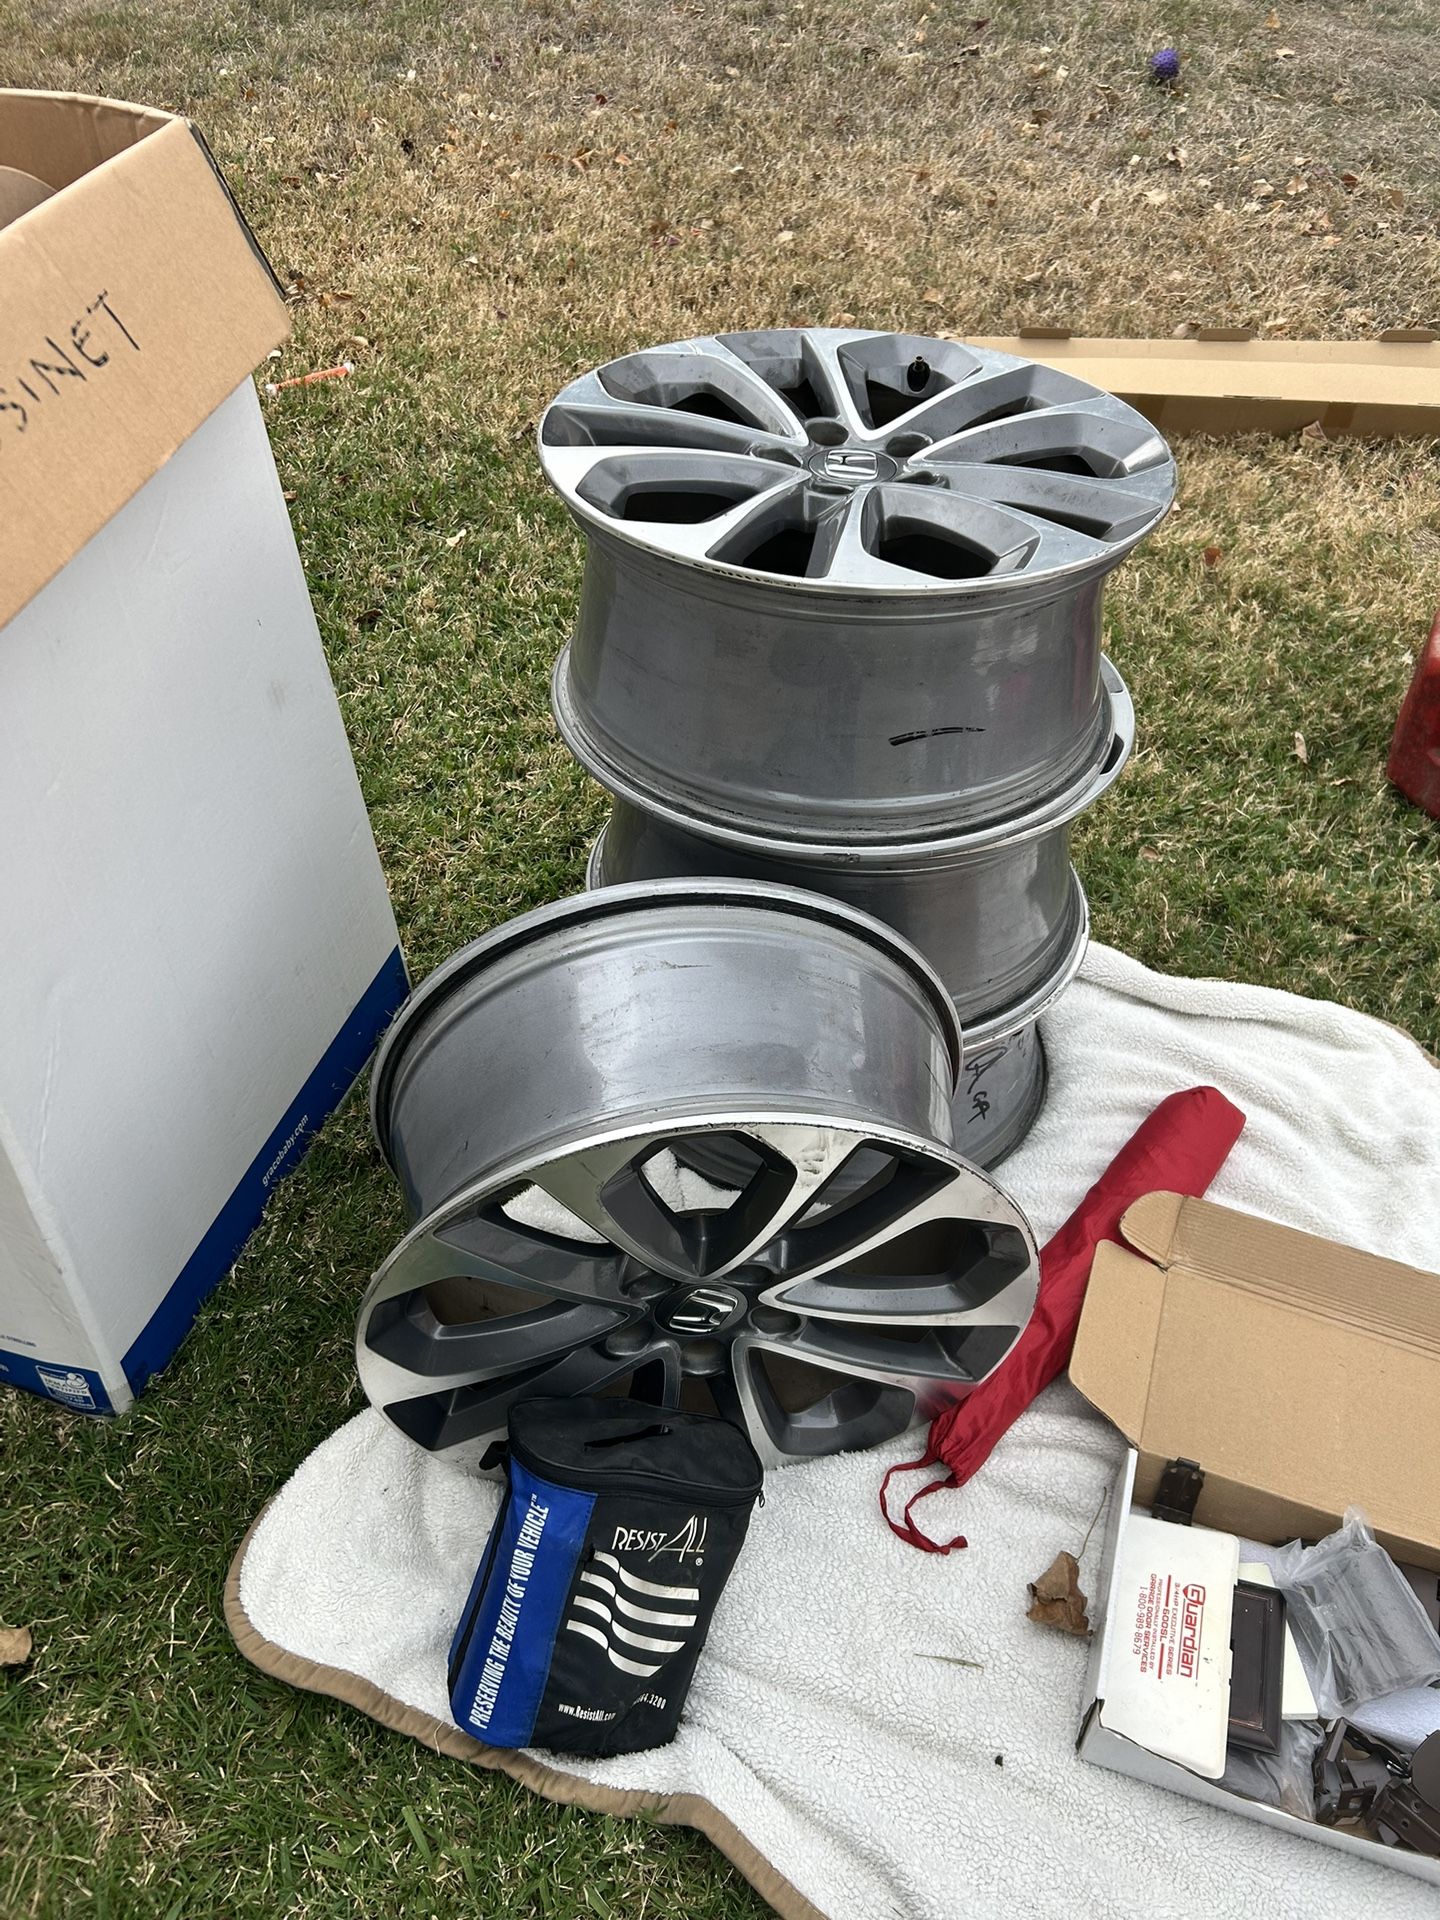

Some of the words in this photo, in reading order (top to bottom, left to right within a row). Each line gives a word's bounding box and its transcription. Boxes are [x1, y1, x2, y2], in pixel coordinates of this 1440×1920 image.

[0, 289, 141, 450] SINET
[261, 1114, 309, 1188] gracobaby.com
[509, 1548, 536, 1582] YOUR
[506, 1578, 526, 1599] OF
[1147, 1573, 1157, 1606] GARAGE
[1153, 1578, 1163, 1628] PROFESSIONALLY
[1173, 1582, 1181, 1607] 3/4HP
[495, 1594, 522, 1642] BEAUTY
[1144, 1605, 1154, 1629] DOOR
[1159, 1608, 1170, 1642] 600SL
[1169, 1607, 1179, 1646] EXECUTIVE
[1180, 1583, 1207, 1678] Guardian
[488, 1635, 511, 1662] THE
[1140, 1629, 1151, 1673] SERVICES
[1149, 1627, 1158, 1660] INSTALLED
[1148, 1661, 1154, 1671] BY
[1165, 1646, 1175, 1676] SERIES
[468, 1658, 506, 1730] PRESERVING
